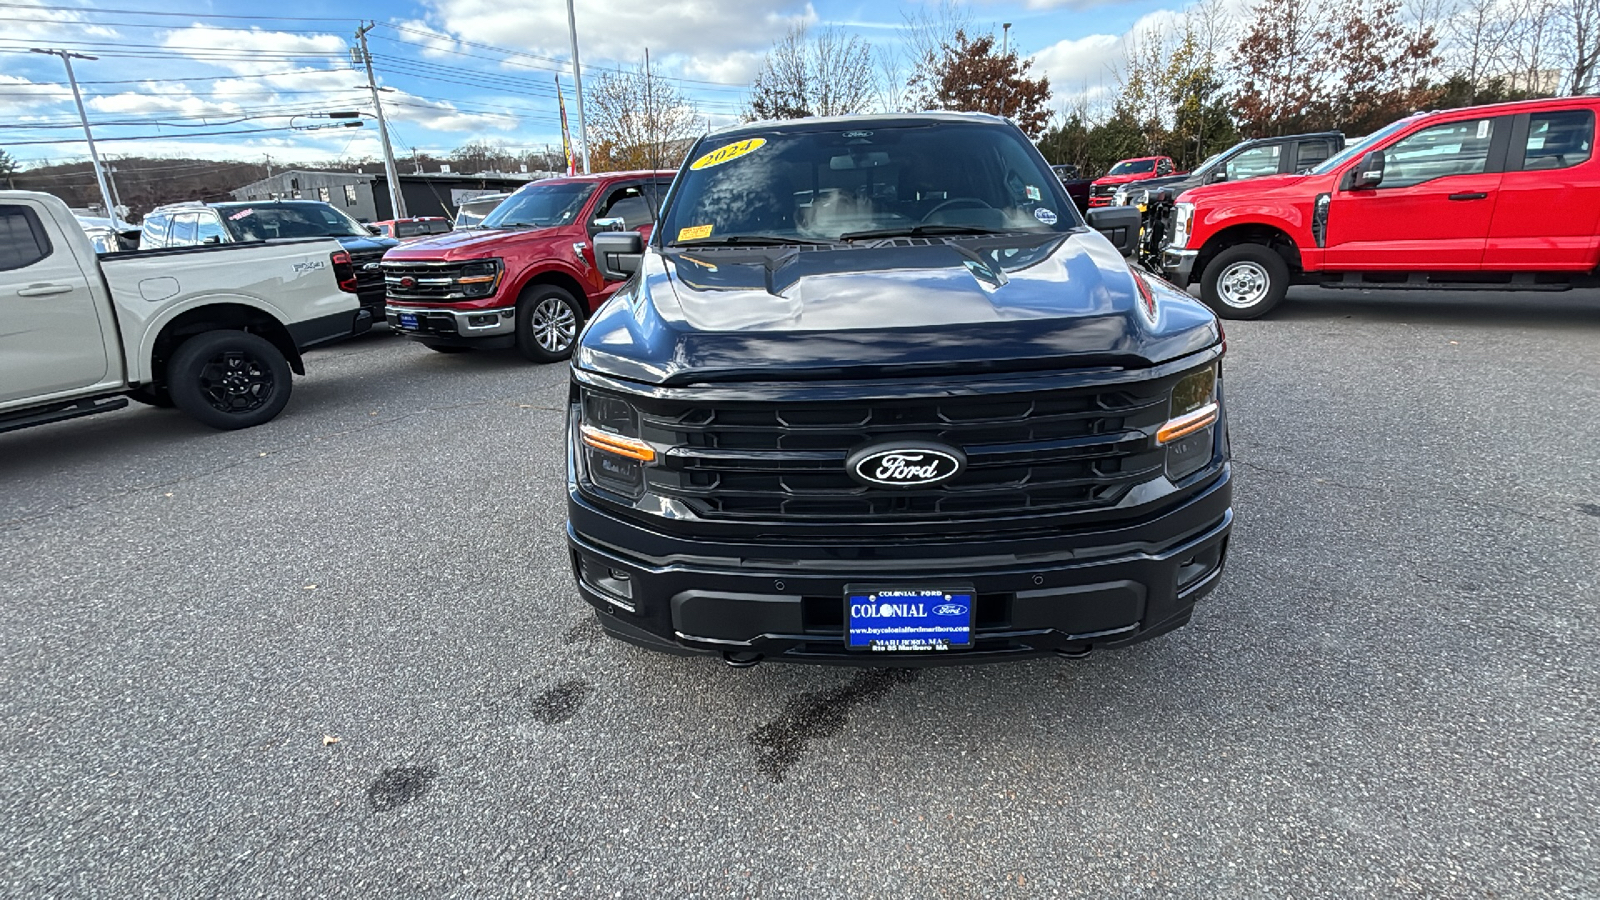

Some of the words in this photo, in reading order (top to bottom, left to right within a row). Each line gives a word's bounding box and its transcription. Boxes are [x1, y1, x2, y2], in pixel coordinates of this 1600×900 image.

[702, 140, 753, 167] 2024
[876, 454, 939, 479] Ford
[851, 603, 928, 618] COLONIAL
[938, 605, 961, 615] Ford
